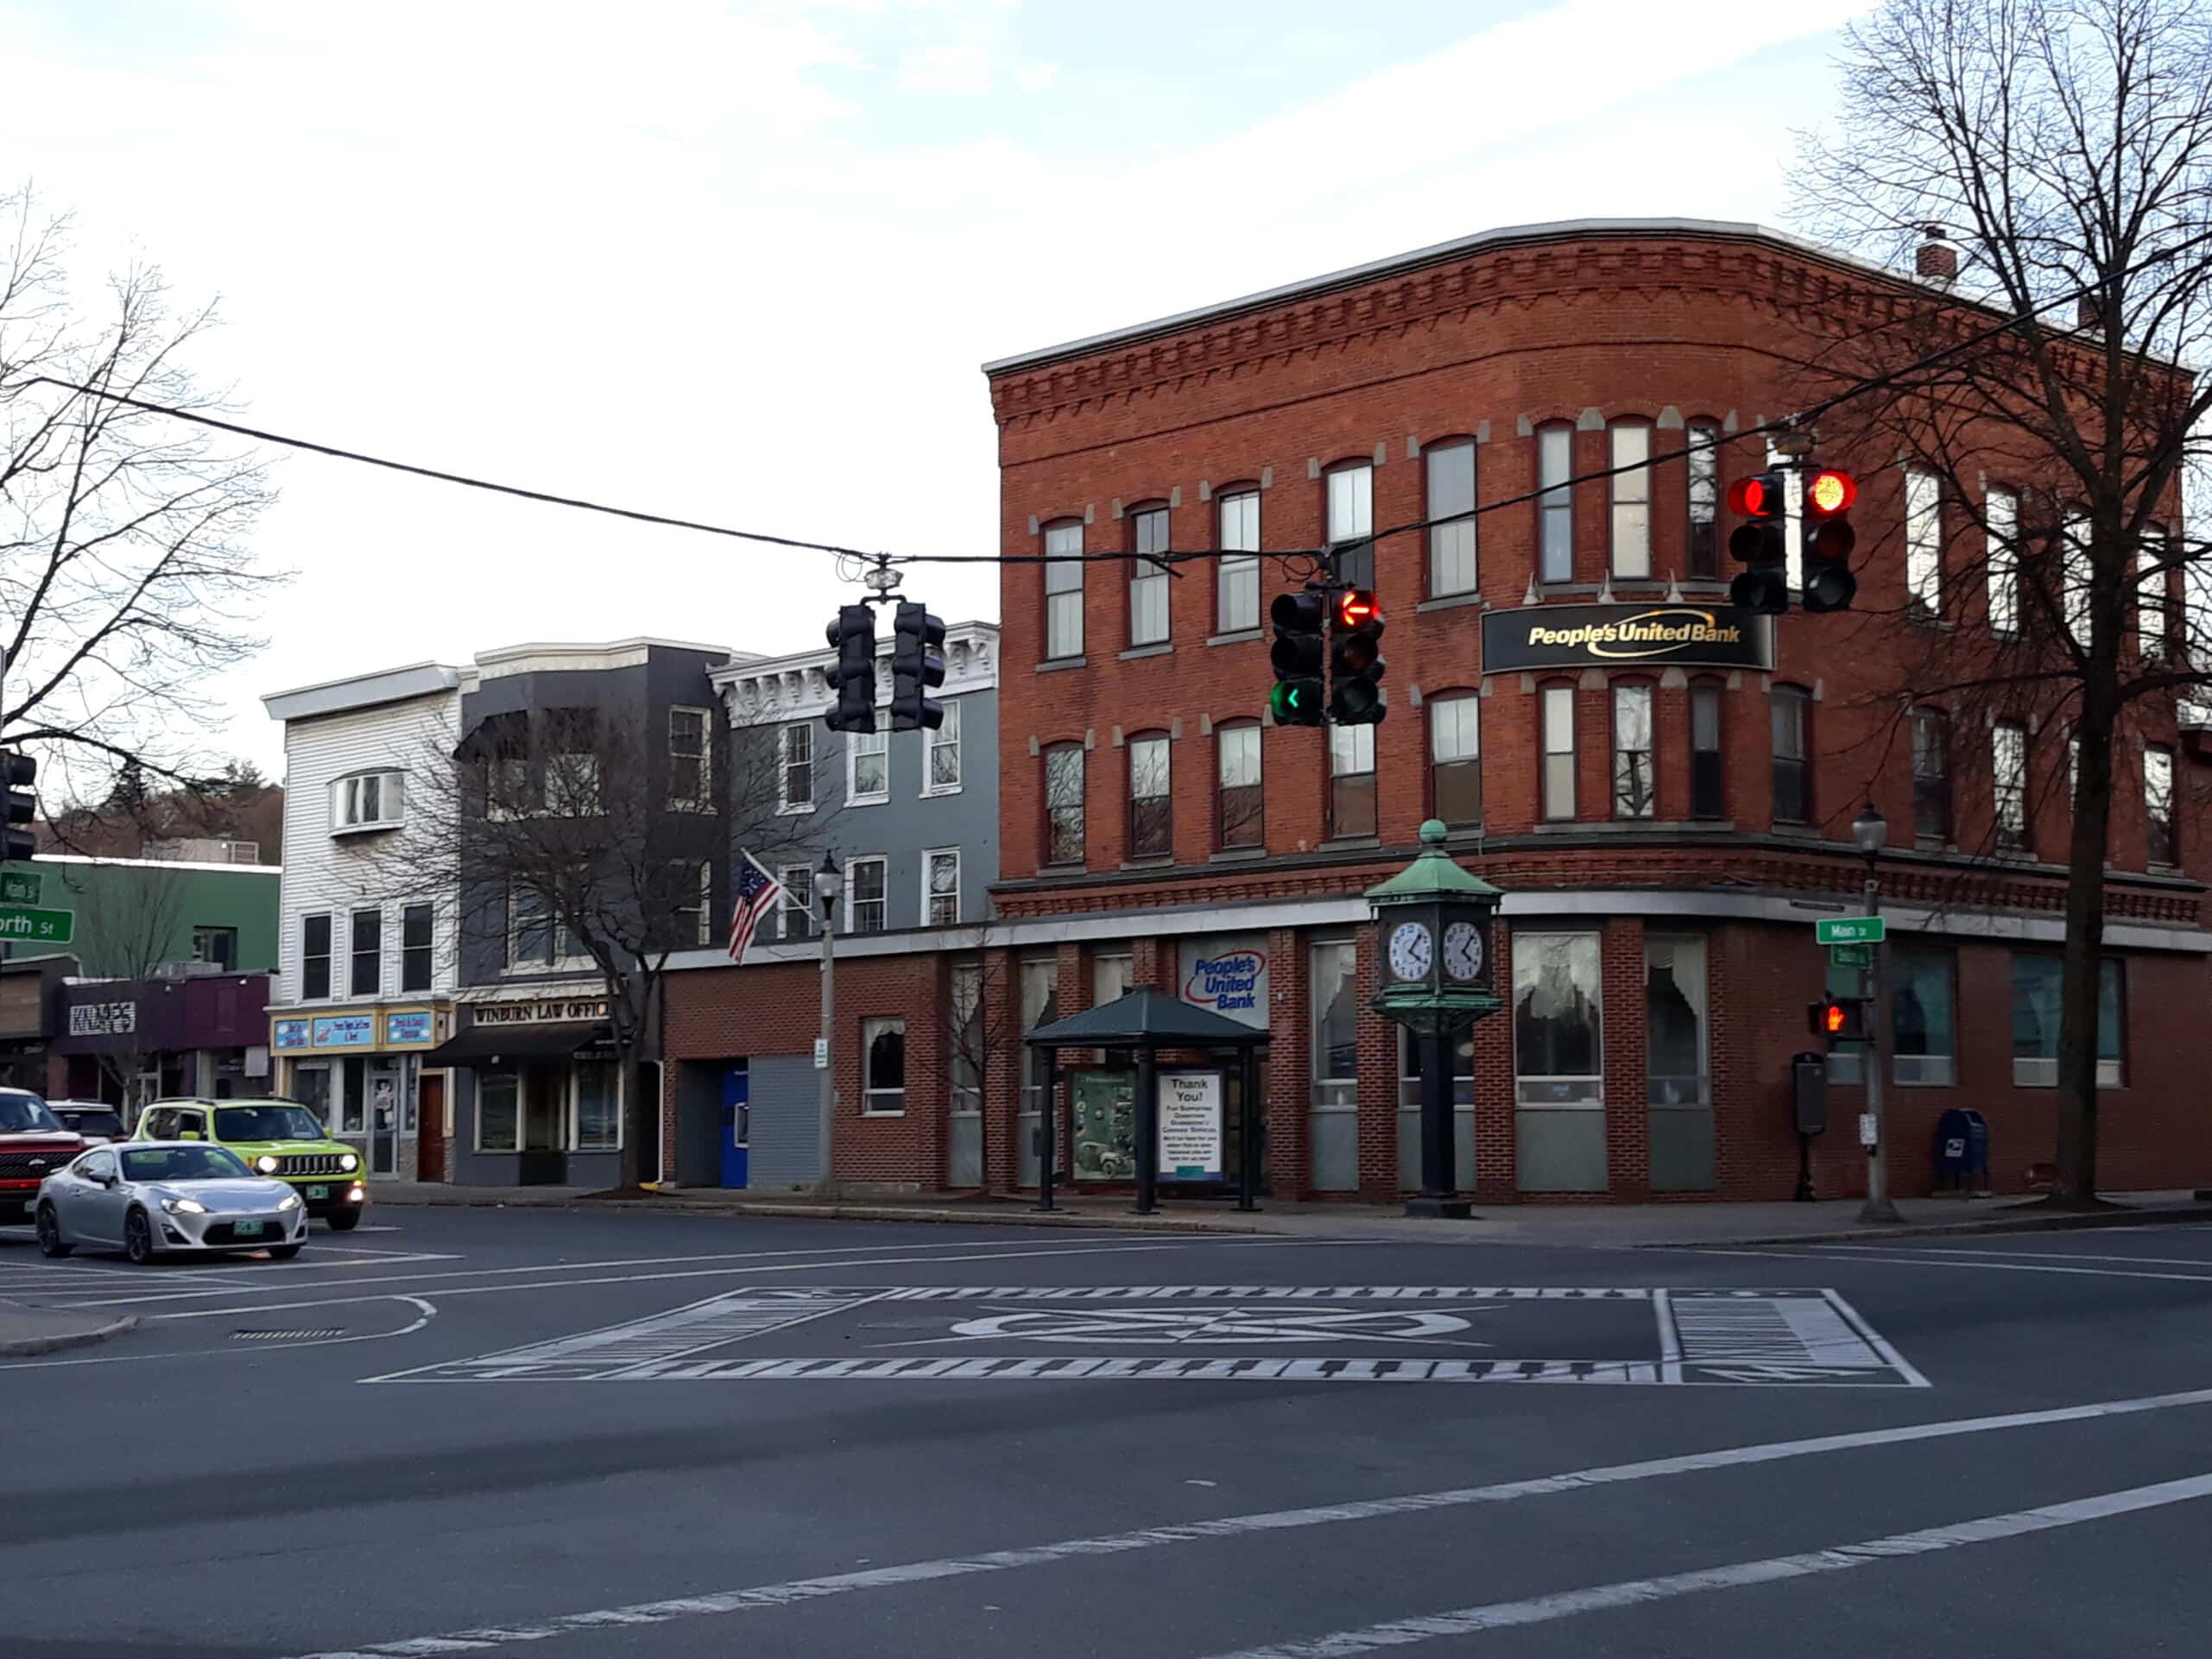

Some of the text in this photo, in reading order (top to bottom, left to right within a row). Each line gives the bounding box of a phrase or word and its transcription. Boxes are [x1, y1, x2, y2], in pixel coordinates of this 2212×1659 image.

[1529, 621, 1741, 647] People's United Bank
[41, 921, 54, 935] St
[1195, 956, 1255, 976] People's
[1205, 974, 1255, 994] United
[1217, 993, 1255, 1010] Bank
[476, 1005, 533, 1023] WINBURN
[537, 1002, 565, 1019] LAW
[1171, 1078, 1209, 1088] Thank
[1176, 1091, 1203, 1101] You!
